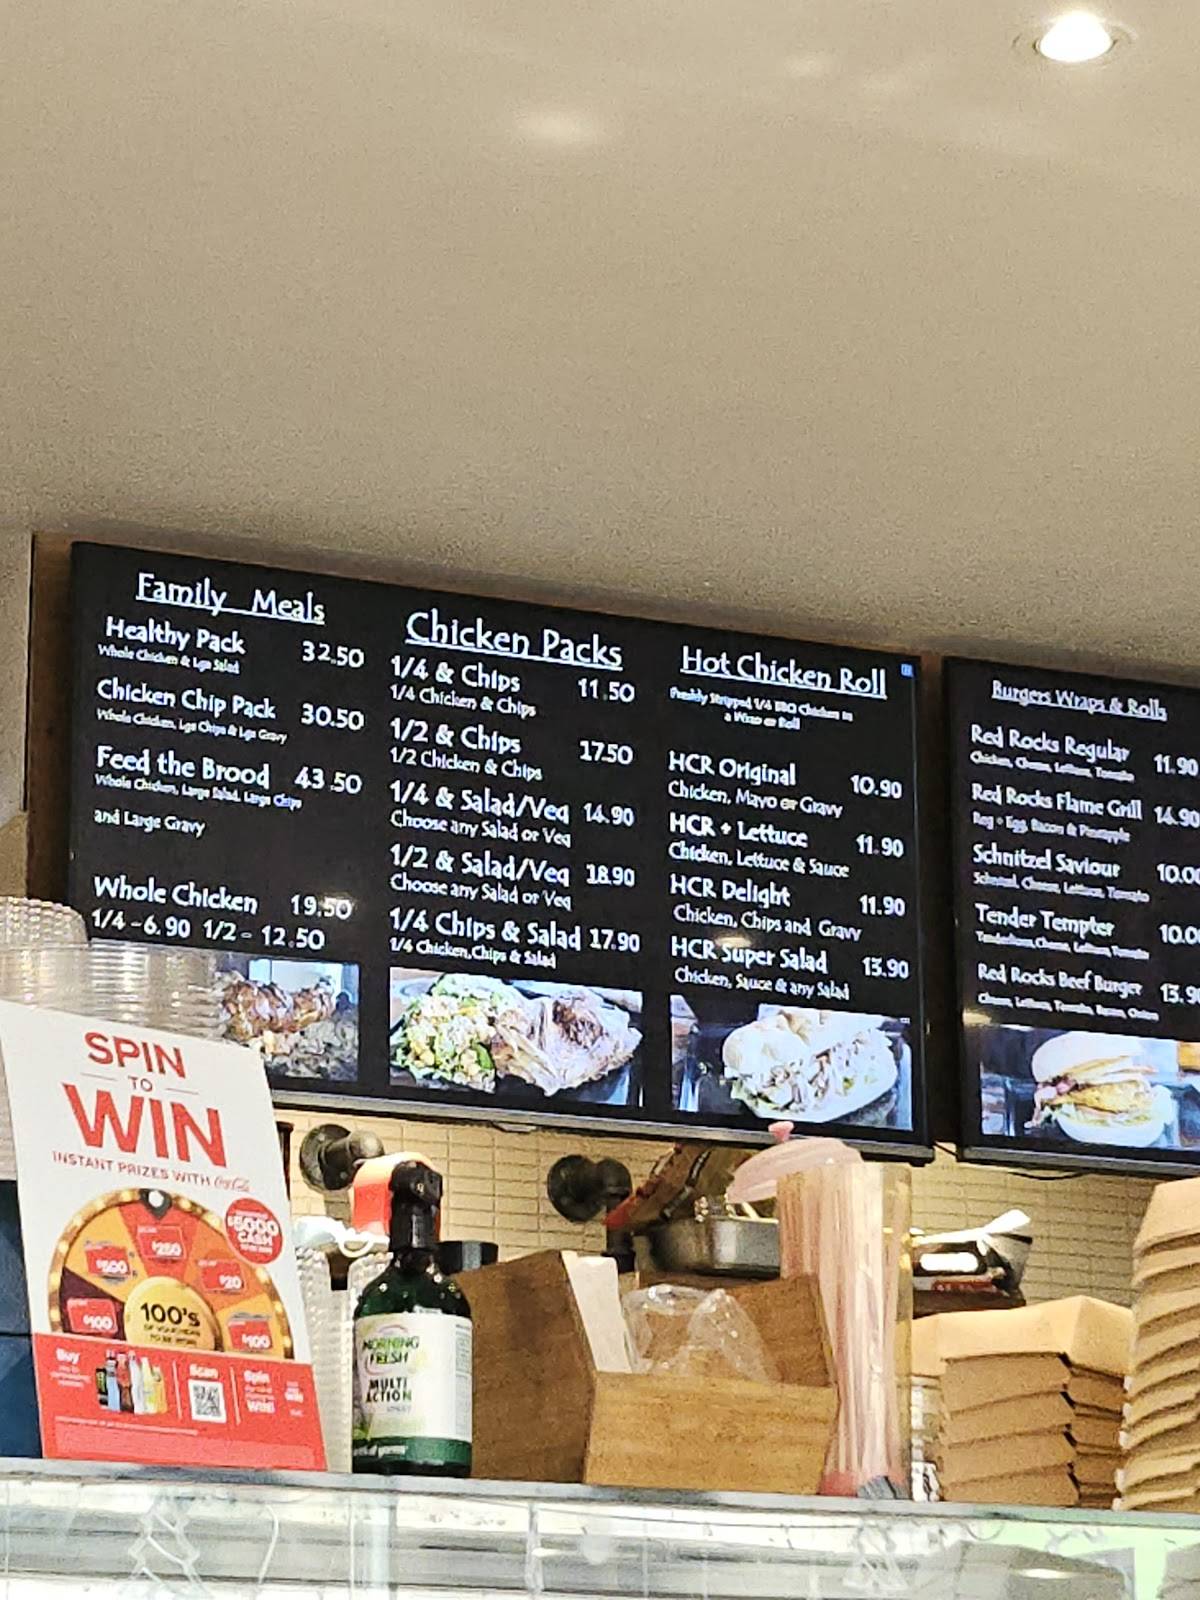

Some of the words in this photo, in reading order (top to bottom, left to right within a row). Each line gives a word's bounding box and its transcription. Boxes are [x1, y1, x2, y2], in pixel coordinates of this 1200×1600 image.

[136, 572, 227, 615] Family
[251, 589, 325, 624] Meals
[106, 616, 190, 650] Healthy
[196, 628, 245, 654] Pack
[405, 608, 530, 658] Chicken
[543, 629, 623, 670] Packs
[302, 641, 364, 668] 32.50
[391, 656, 428, 680] 1/4
[435, 662, 454, 685] &
[461, 663, 520, 692] Chips
[578, 677, 635, 703] 11.50
[680, 646, 730, 676] Hot
[737, 652, 832, 690] Chicken
[840, 668, 888, 700] Roll
[97, 677, 176, 707] Chicken
[182, 688, 226, 717] Chip
[232, 695, 275, 719] Pack
[390, 685, 415, 701] 1/4
[419, 687, 477, 710] Chicken
[480, 696, 494, 711] &
[496, 697, 537, 719] Chips
[992, 680, 1051, 707] Burgers
[1108, 698, 1123, 716] &
[1127, 698, 1168, 721] Rolls
[301, 703, 364, 730] 30.50
[391, 717, 428, 742] 1/2
[435, 724, 454, 747] &
[461, 724, 520, 754] Chips
[971, 724, 1003, 748] Red
[1009, 729, 1059, 753] Rocks
[1065, 736, 1130, 763] Regular
[97, 745, 150, 775] Feed
[157, 750, 195, 777] the
[202, 757, 270, 790] Brood
[295, 766, 362, 794] 43.50
[390, 747, 416, 765] 1/2
[420, 749, 481, 774] Chicken
[484, 759, 498, 775] &
[501, 760, 543, 781] Chips
[669, 751, 715, 775] HCR
[719, 758, 796, 786] Original
[1153, 753, 1199, 776] 11.90
[390, 779, 429, 805] 1/4
[435, 787, 454, 809] &
[668, 780, 731, 805] Chicken,
[735, 788, 777, 809] Mayo
[800, 796, 843, 819] Gravy
[850, 774, 902, 799] 10.90
[972, 783, 1002, 805] Red
[1006, 786, 1053, 809] Rocks
[1057, 791, 1104, 816] Flame
[1107, 799, 1143, 820] Grill
[94, 808, 119, 826] and
[124, 811, 161, 832] Large
[164, 816, 205, 837] Gravy
[390, 809, 448, 832] Choose
[450, 819, 479, 839] any
[481, 820, 518, 842] Salad
[521, 830, 540, 842] or
[584, 803, 635, 827] 14.90
[669, 812, 716, 836] HCR
[738, 821, 808, 848] Lettuce
[1153, 806, 1200, 828] 14.90
[390, 843, 428, 868] 1/2
[435, 850, 454, 873] &
[668, 841, 732, 866] Chicken,
[737, 849, 789, 872] Lettuce
[793, 859, 805, 874] &
[809, 859, 850, 878] Sauce
[856, 834, 904, 858] 11.90
[973, 842, 1051, 871] Schnitzel
[1056, 854, 1121, 878] Saviour
[94, 875, 166, 904] Whole
[171, 881, 258, 915] Chicken
[390, 872, 448, 896] Choose
[450, 883, 479, 901] any
[481, 883, 518, 904] Salad
[521, 894, 540, 905] or
[670, 873, 716, 899] HCR
[722, 878, 791, 908] Delight
[859, 894, 906, 917] 11.90
[290, 894, 353, 920] 19.50
[673, 903, 738, 929] Chicken,
[741, 911, 782, 934] Chips
[785, 917, 812, 937] and
[818, 920, 862, 942] Gravy
[975, 903, 1036, 928] Tender
[1039, 910, 1115, 939] Tempter
[92, 909, 125, 931] 1/4
[203, 919, 236, 941] 1/2
[262, 924, 325, 949] 12.50
[390, 907, 429, 933] 1/4
[435, 909, 495, 941] Chips
[502, 921, 520, 944] &
[527, 920, 581, 951] Salad
[590, 928, 641, 953] 17.90
[1159, 924, 1200, 945] 10.0
[390, 937, 413, 953] 1/4
[510, 953, 521, 965] &
[524, 952, 556, 969] Salad
[671, 936, 716, 960] HCR
[721, 944, 776, 969] Super
[780, 947, 828, 974] Salad
[674, 966, 732, 988] Chicken,
[735, 973, 772, 991] Sauce
[774, 978, 787, 994] &
[790, 984, 814, 1000] any
[817, 981, 850, 1001] Salad
[978, 963, 1007, 985] Red
[1010, 966, 1055, 987] Rocks
[1059, 970, 1092, 991] Beef
[1094, 975, 1143, 999] Burger
[85, 1031, 186, 1079] SPIN
[128, 1075, 154, 1092] TO
[62, 1083, 227, 1168] WIN
[53, 1151, 112, 1170] INSTANT
[118, 1161, 169, 1179] PRIZES
[174, 1170, 211, 1185] WITH
[141, 1302, 200, 1327] 100's
